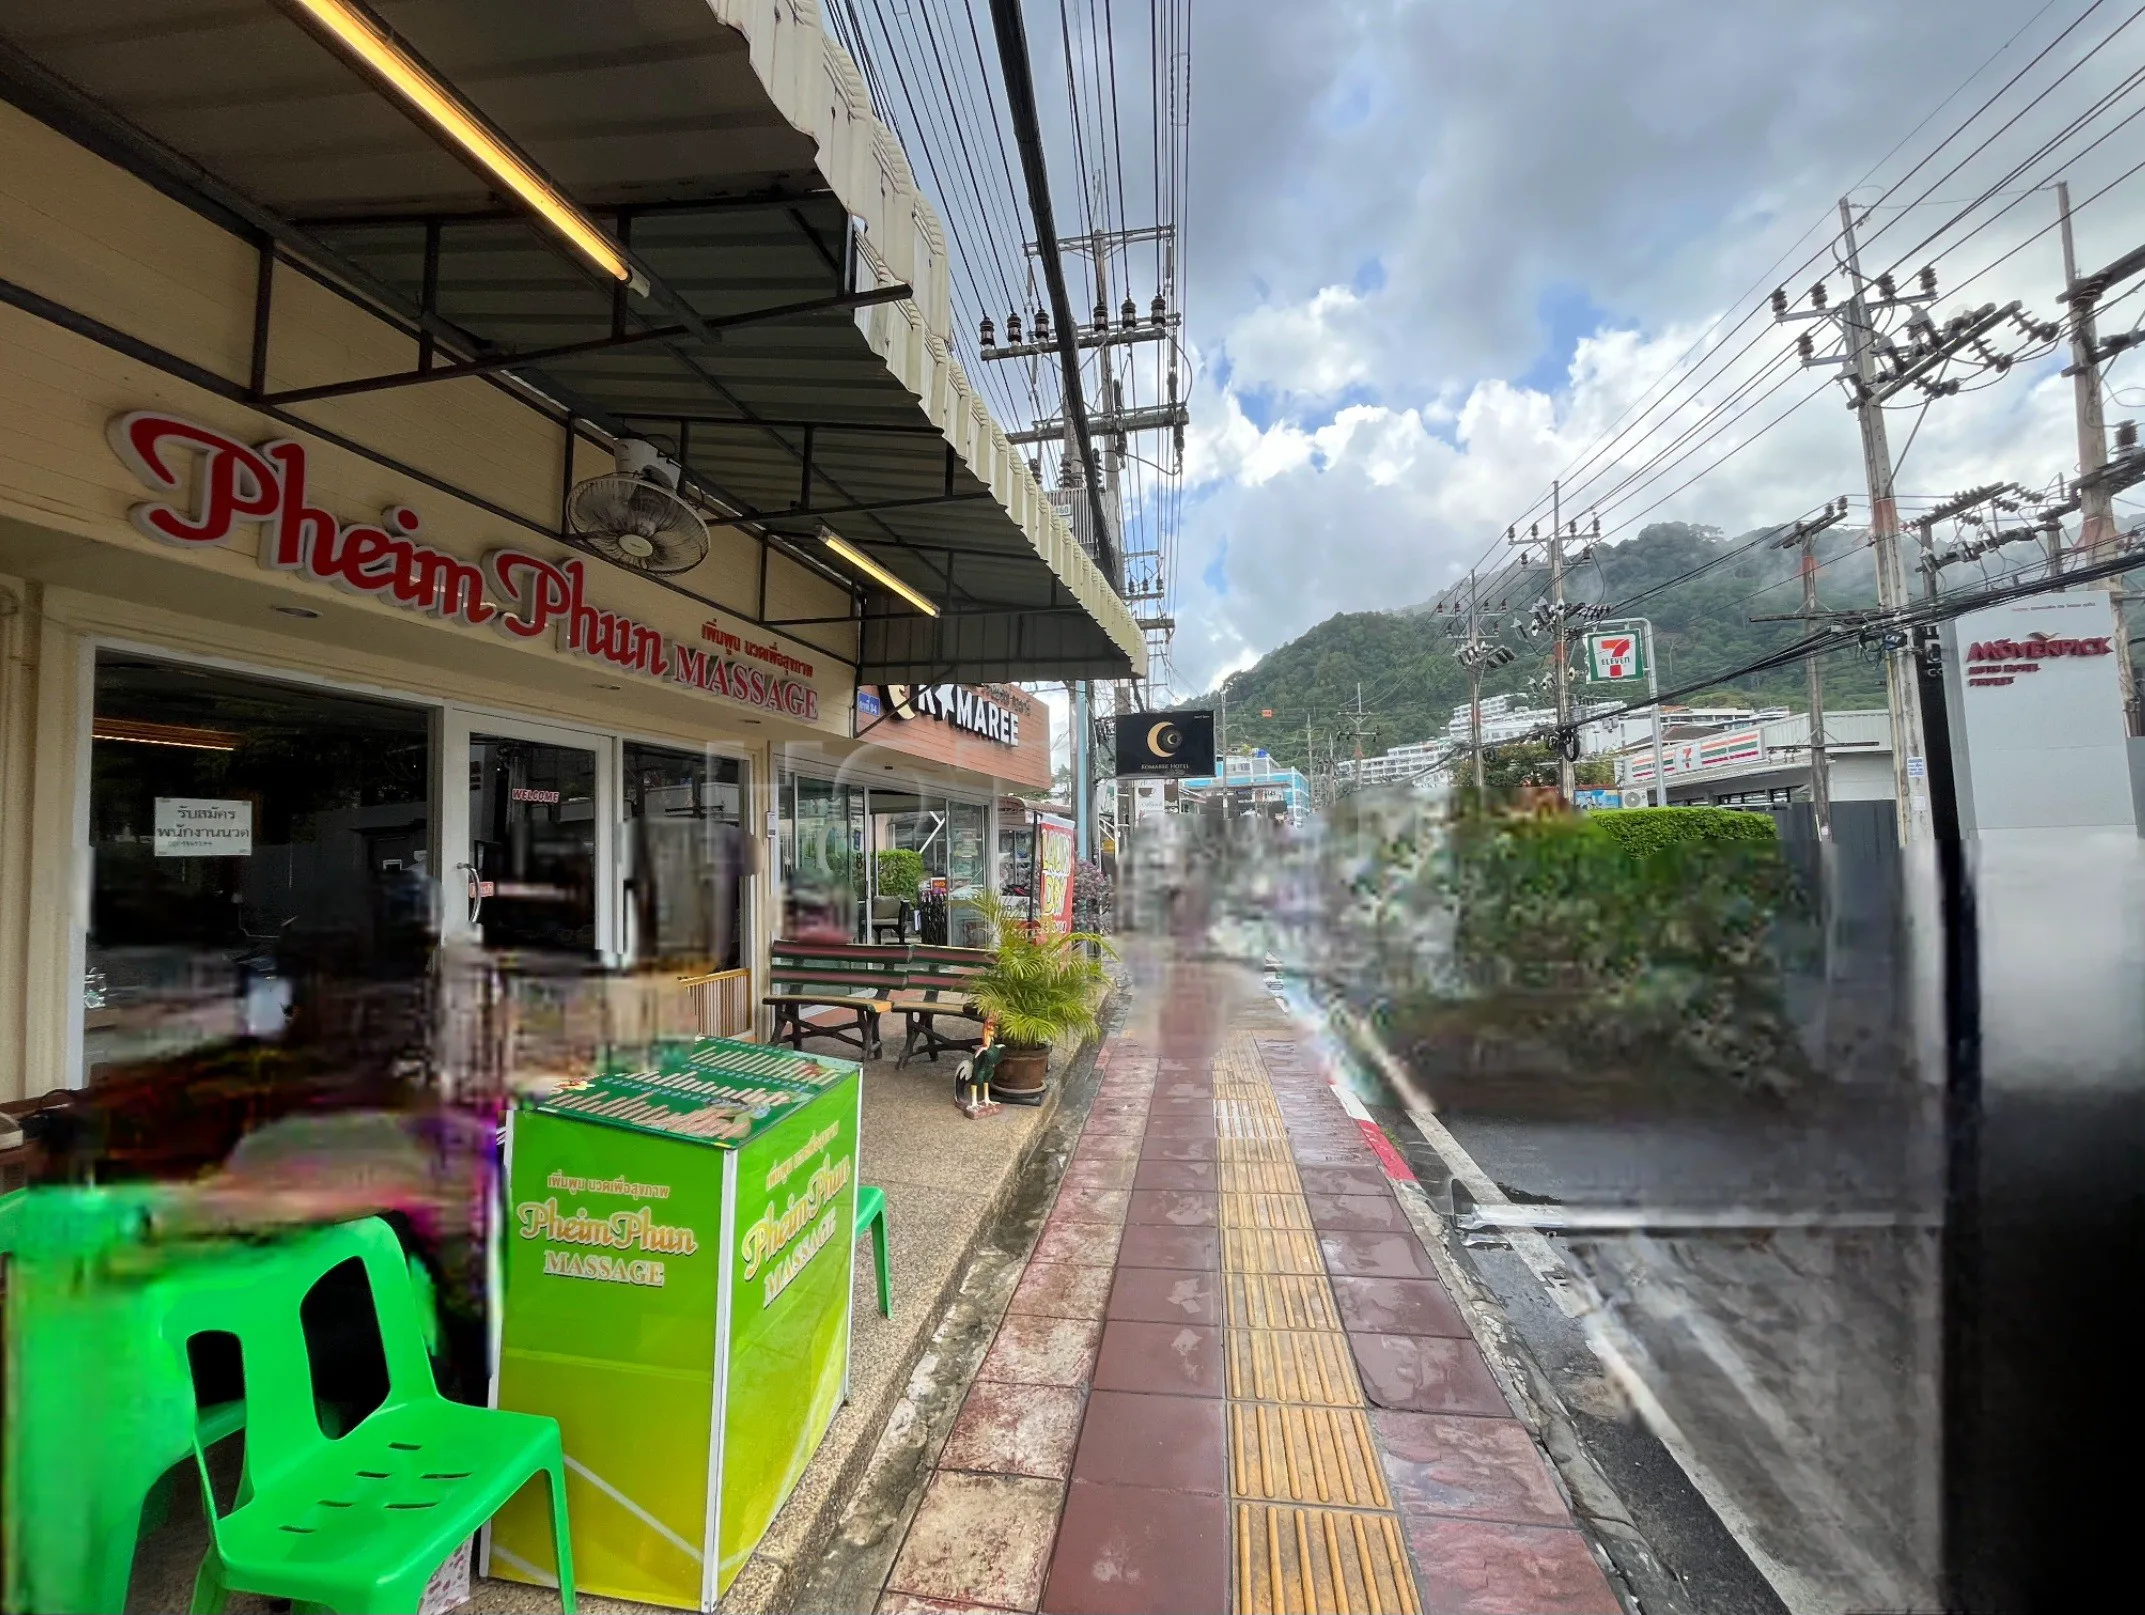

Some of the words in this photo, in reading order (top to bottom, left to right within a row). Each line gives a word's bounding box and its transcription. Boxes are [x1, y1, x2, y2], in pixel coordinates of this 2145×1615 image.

[107, 411, 498, 627] Pheim
[483, 549, 669, 676] Phun
[1600, 638, 1630, 677] 7
[674, 643, 820, 722] MASSAGE
[177, 805, 236, 819] รับสมัคร
[512, 789, 559, 803] WELCOME
[157, 823, 249, 837] พนักงานนวด
[517, 1197, 613, 1247] Pheim
[609, 1206, 699, 1255] Phun
[544, 1250, 665, 1287] MASSAGE
[764, 1207, 837, 1309] MASSAGE
